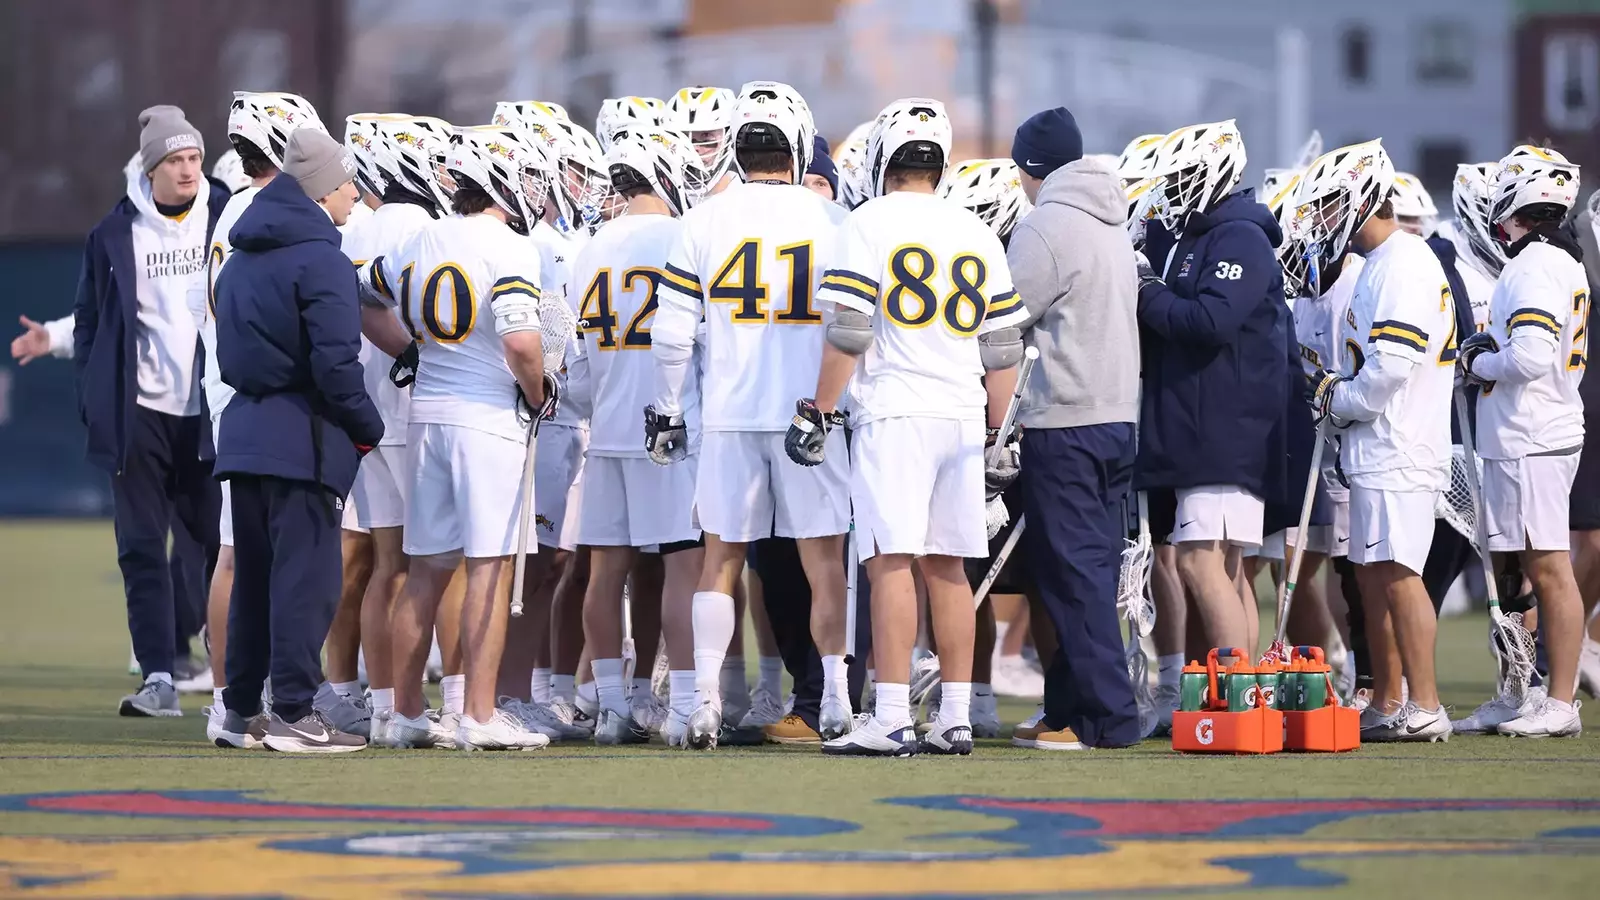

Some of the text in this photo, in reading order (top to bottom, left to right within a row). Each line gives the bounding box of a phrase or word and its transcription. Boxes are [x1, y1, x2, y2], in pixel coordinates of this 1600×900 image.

[147, 260, 208, 279] LACROSS
[707, 237, 823, 324] 41
[1215, 260, 1244, 281] 38
[397, 261, 477, 344] 10
[882, 243, 989, 337] 88
[1470, 300, 1488, 309] CAA
[577, 266, 663, 351] 42
[985, 556, 1004, 585] STX
[1195, 718, 1214, 745] G
